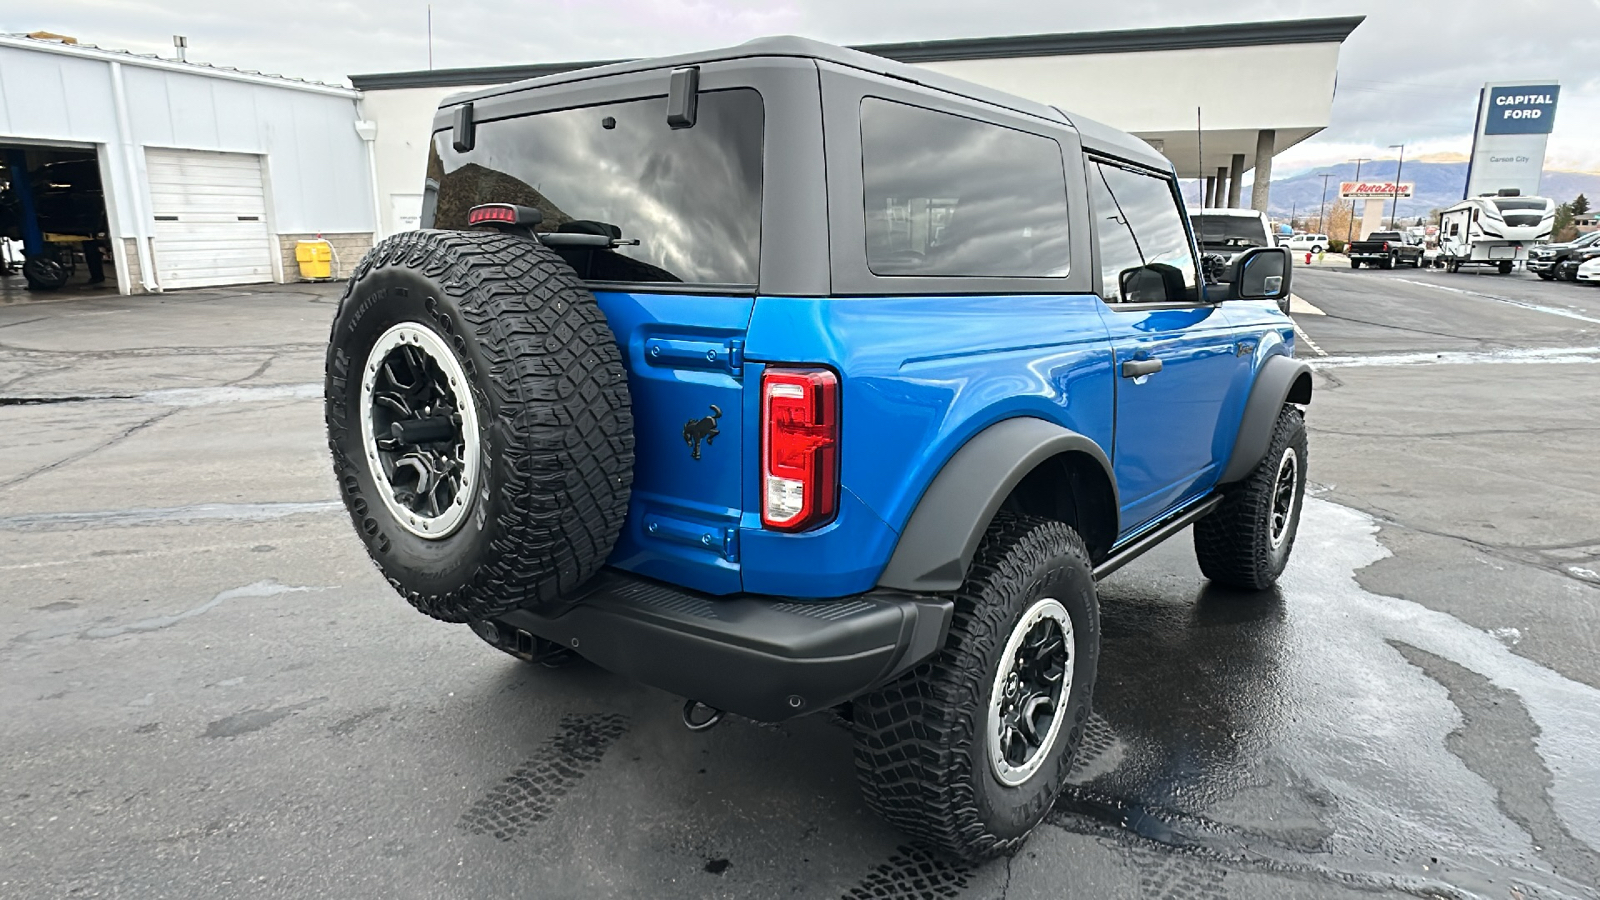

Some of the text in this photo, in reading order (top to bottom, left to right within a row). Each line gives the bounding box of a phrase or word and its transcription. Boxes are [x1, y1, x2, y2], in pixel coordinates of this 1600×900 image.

[1496, 95, 1553, 106] CAPITAL
[1503, 109, 1542, 119] FORD
[1516, 156, 1529, 164] City
